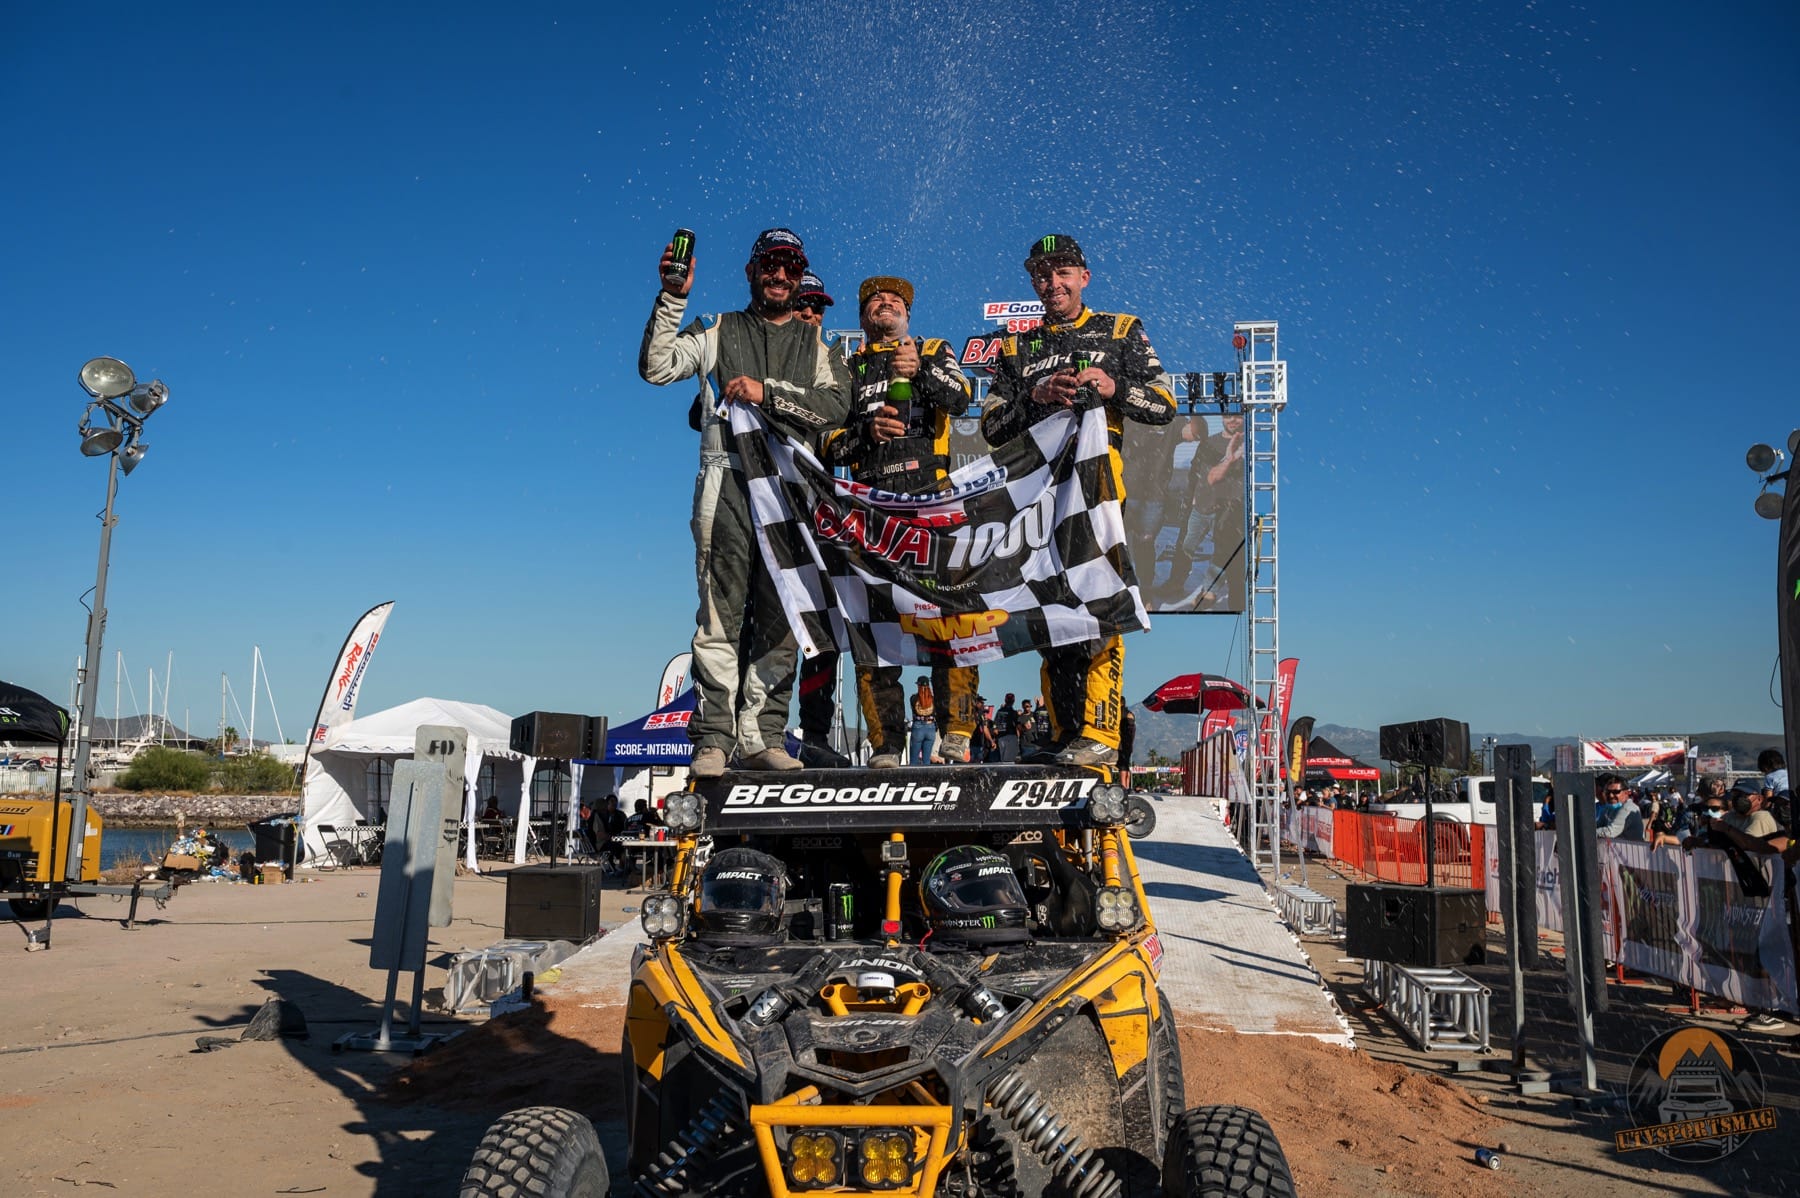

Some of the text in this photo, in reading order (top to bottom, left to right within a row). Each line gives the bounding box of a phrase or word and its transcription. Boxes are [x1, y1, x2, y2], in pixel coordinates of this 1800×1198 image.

[725, 782, 961, 811] BFGoodrich Tires
[1006, 781, 1083, 808] 2944
[716, 871, 762, 880] IMPACT
[838, 958, 923, 976] UNION
